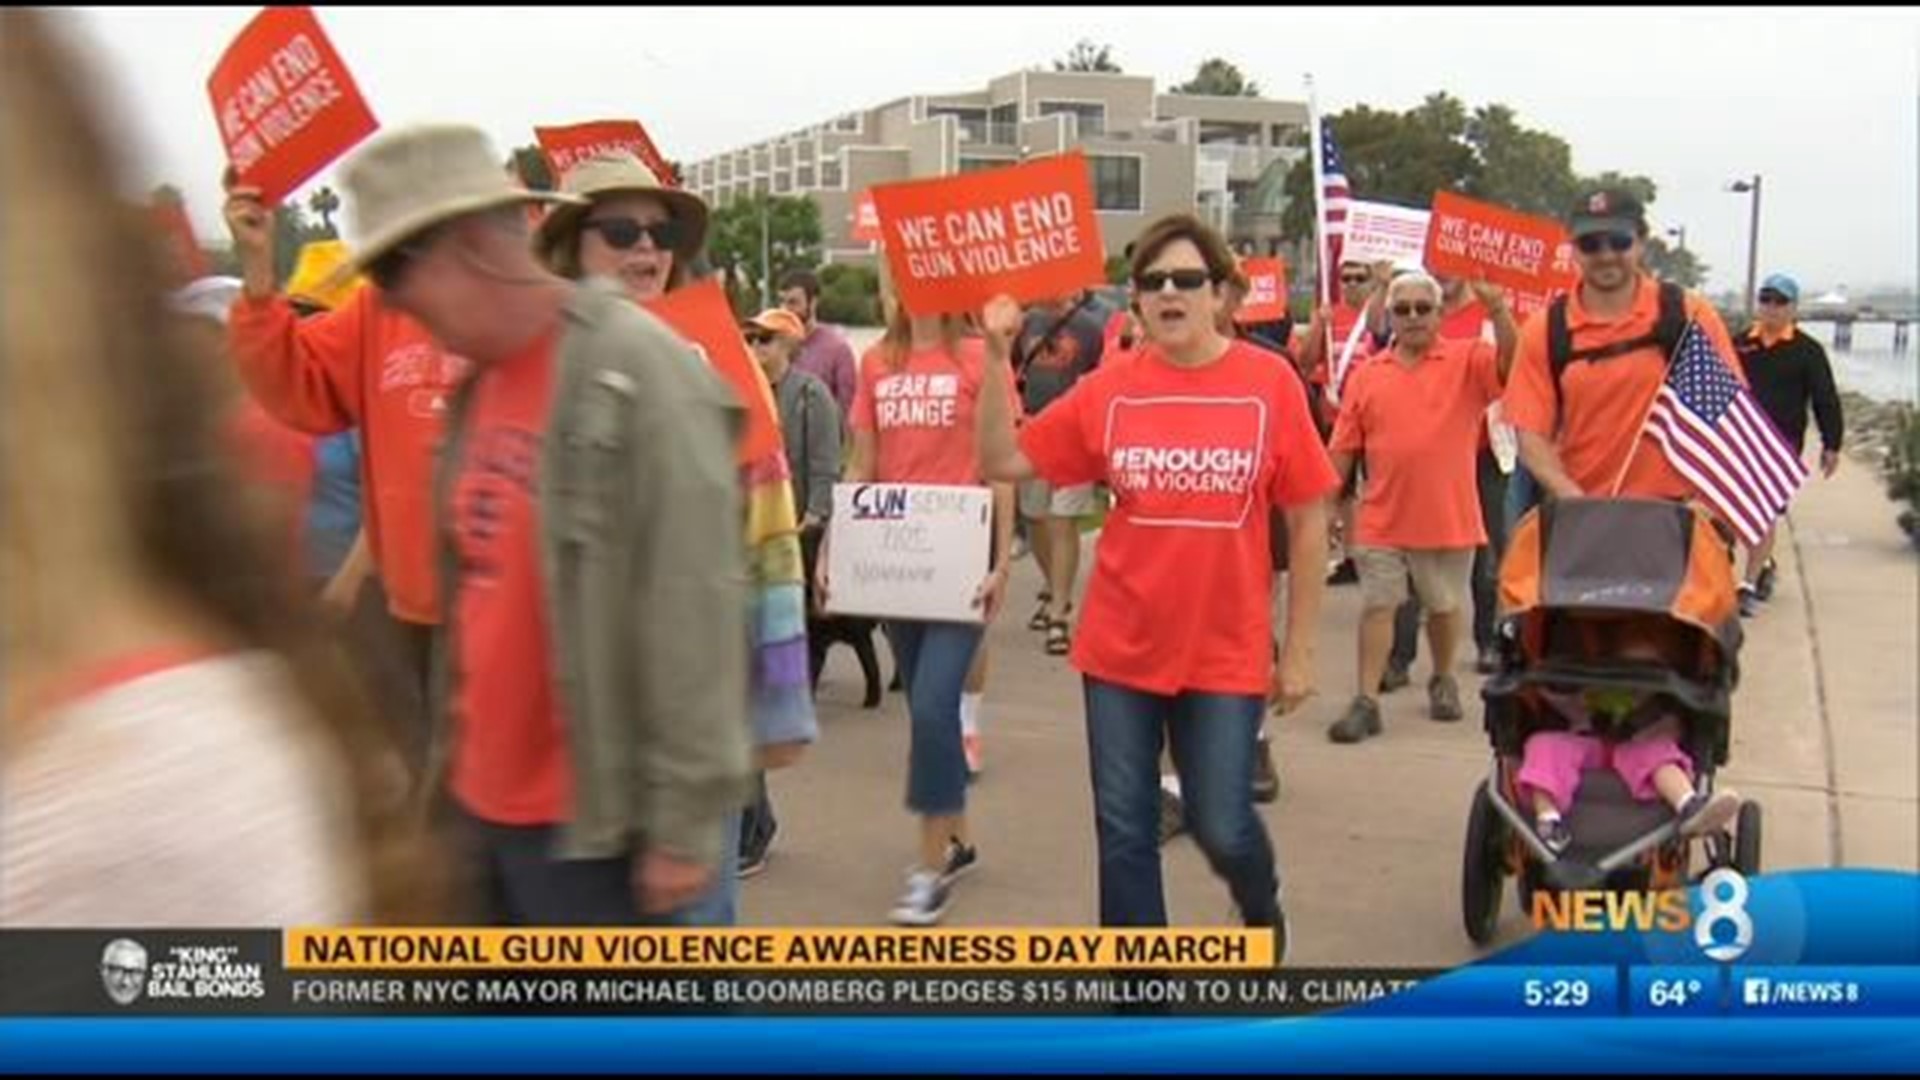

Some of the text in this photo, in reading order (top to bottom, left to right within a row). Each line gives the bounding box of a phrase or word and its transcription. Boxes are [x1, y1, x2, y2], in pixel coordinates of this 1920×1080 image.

[271, 33, 321, 89] END
[255, 67, 343, 149] VIOLENCE
[896, 191, 1074, 250] WE CAN END
[1438, 215, 1545, 259] WE CAN END
[907, 225, 1082, 279] GUN VIOLENCE
[1435, 234, 1540, 275] GUN VIOLENCE
[1112, 447, 1253, 477] #ENOUGH
[1154, 471, 1247, 494] VIOLENCE
[852, 485, 907, 519] GUN
